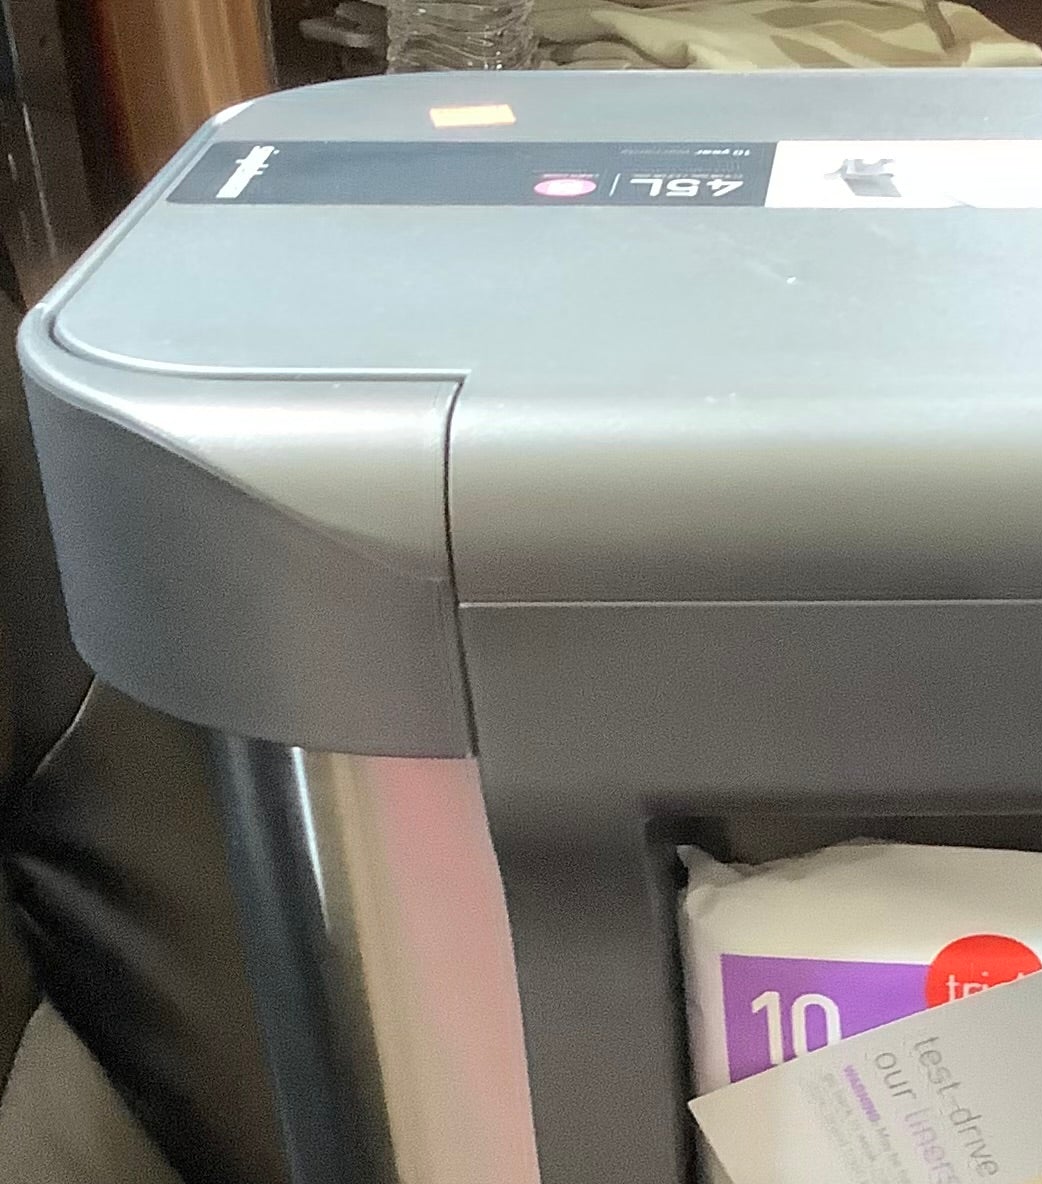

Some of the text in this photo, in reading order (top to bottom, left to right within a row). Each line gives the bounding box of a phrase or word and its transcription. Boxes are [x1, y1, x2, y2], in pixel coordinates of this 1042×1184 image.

[695, 148, 731, 158] year
[732, 148, 751, 157] 10
[630, 178, 744, 197] 45L
[751, 990, 842, 1066] 10
[874, 1051, 917, 1098] our
[914, 1036, 999, 1178] test-drive
